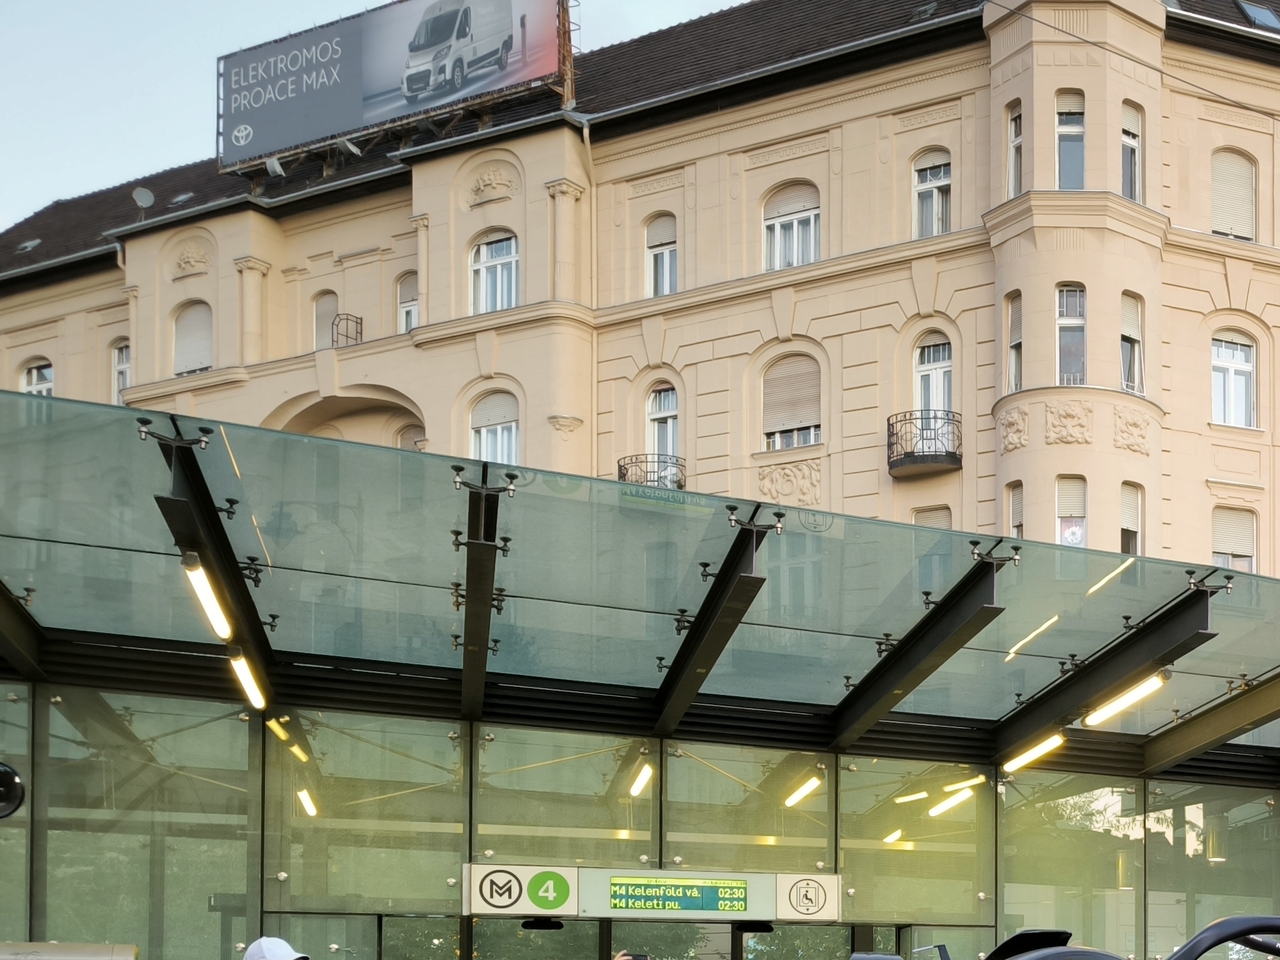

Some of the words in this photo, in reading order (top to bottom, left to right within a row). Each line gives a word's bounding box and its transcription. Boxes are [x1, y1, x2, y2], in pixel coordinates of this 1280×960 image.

[230, 37, 343, 89] ELEKTROMOS
[230, 77, 297, 114] PROACE
[302, 63, 341, 94] MAX
[537, 880, 557, 901] 4
[610, 885, 626, 896] M4
[628, 885, 683, 897] Kelenföld
[685, 887, 701, 898] vá.
[718, 888, 745, 899] 02:30
[610, 898, 626, 908] M4
[628, 898, 663, 909] Keleti
[665, 901, 681, 911] pu.
[717, 900, 745, 911] 02:30
